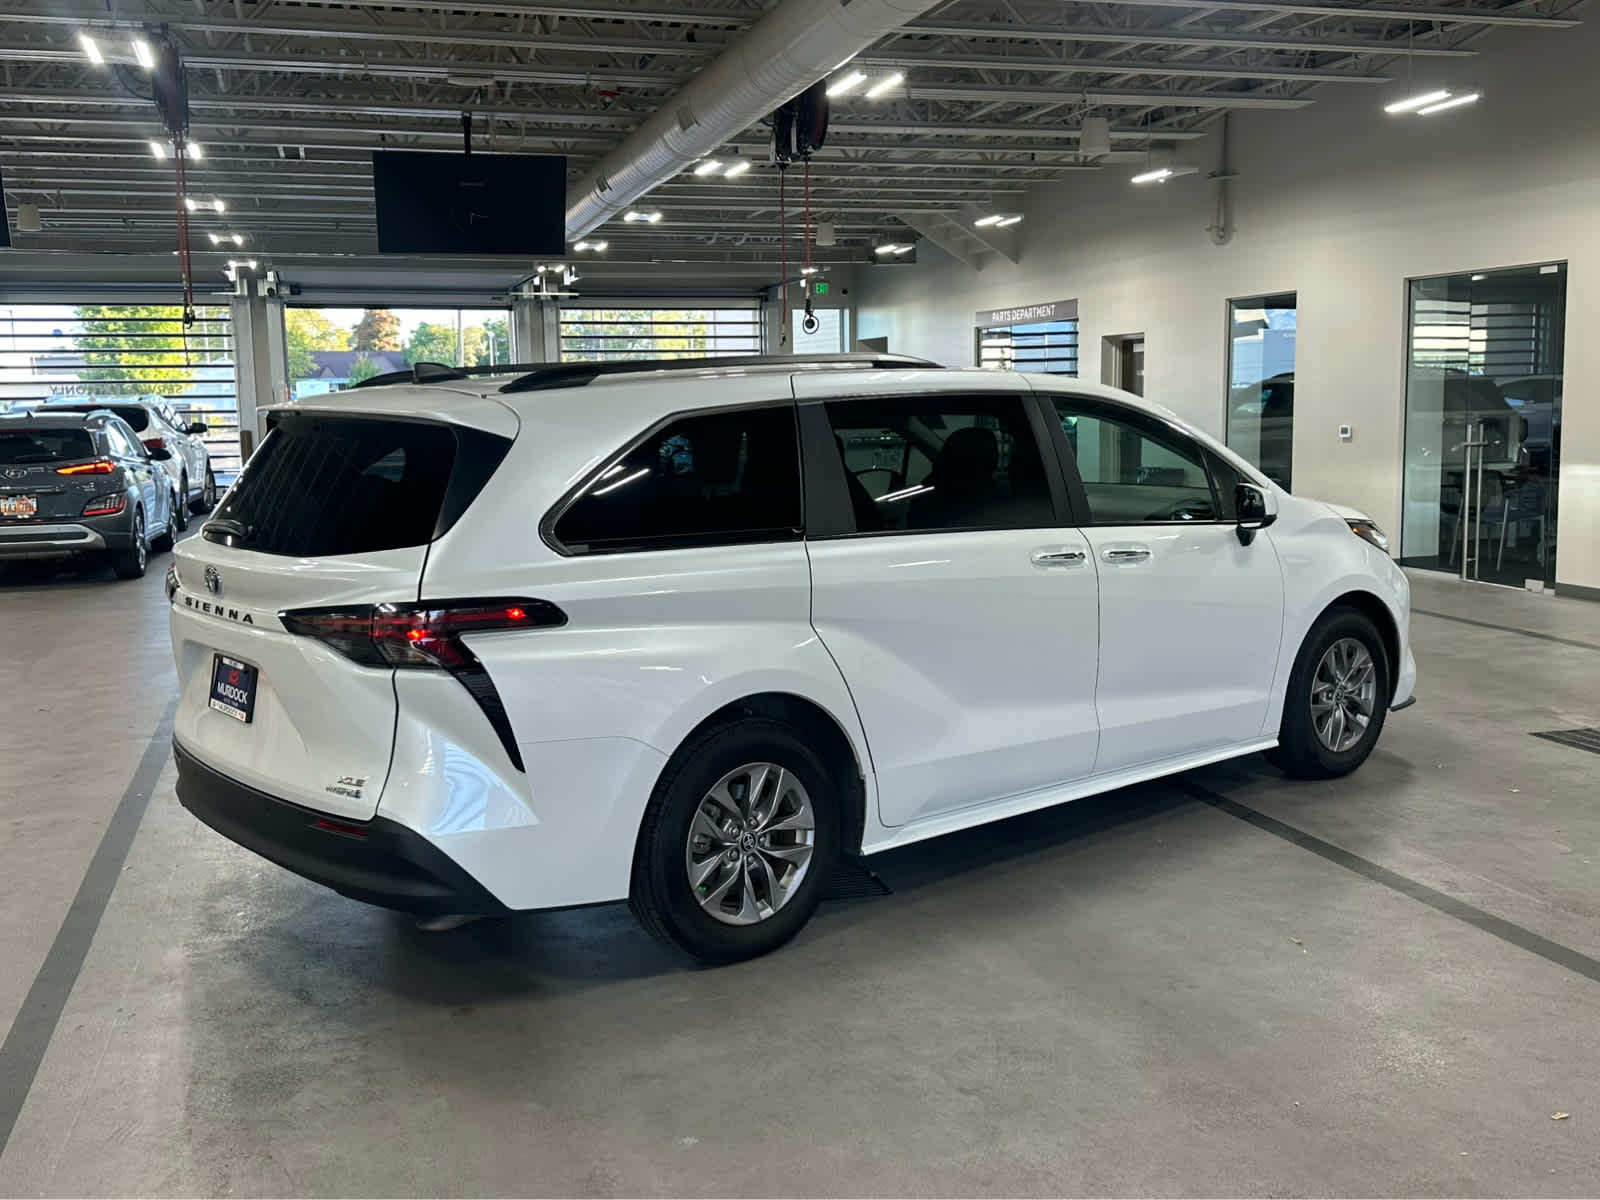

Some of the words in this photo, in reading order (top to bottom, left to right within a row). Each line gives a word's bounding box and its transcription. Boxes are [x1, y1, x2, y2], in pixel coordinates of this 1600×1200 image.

[991, 310, 1011, 322] PARTS
[1011, 304, 1056, 321] DEPARTMENT
[184, 596, 254, 624] SIENNA
[217, 681, 249, 705] MURDOCK
